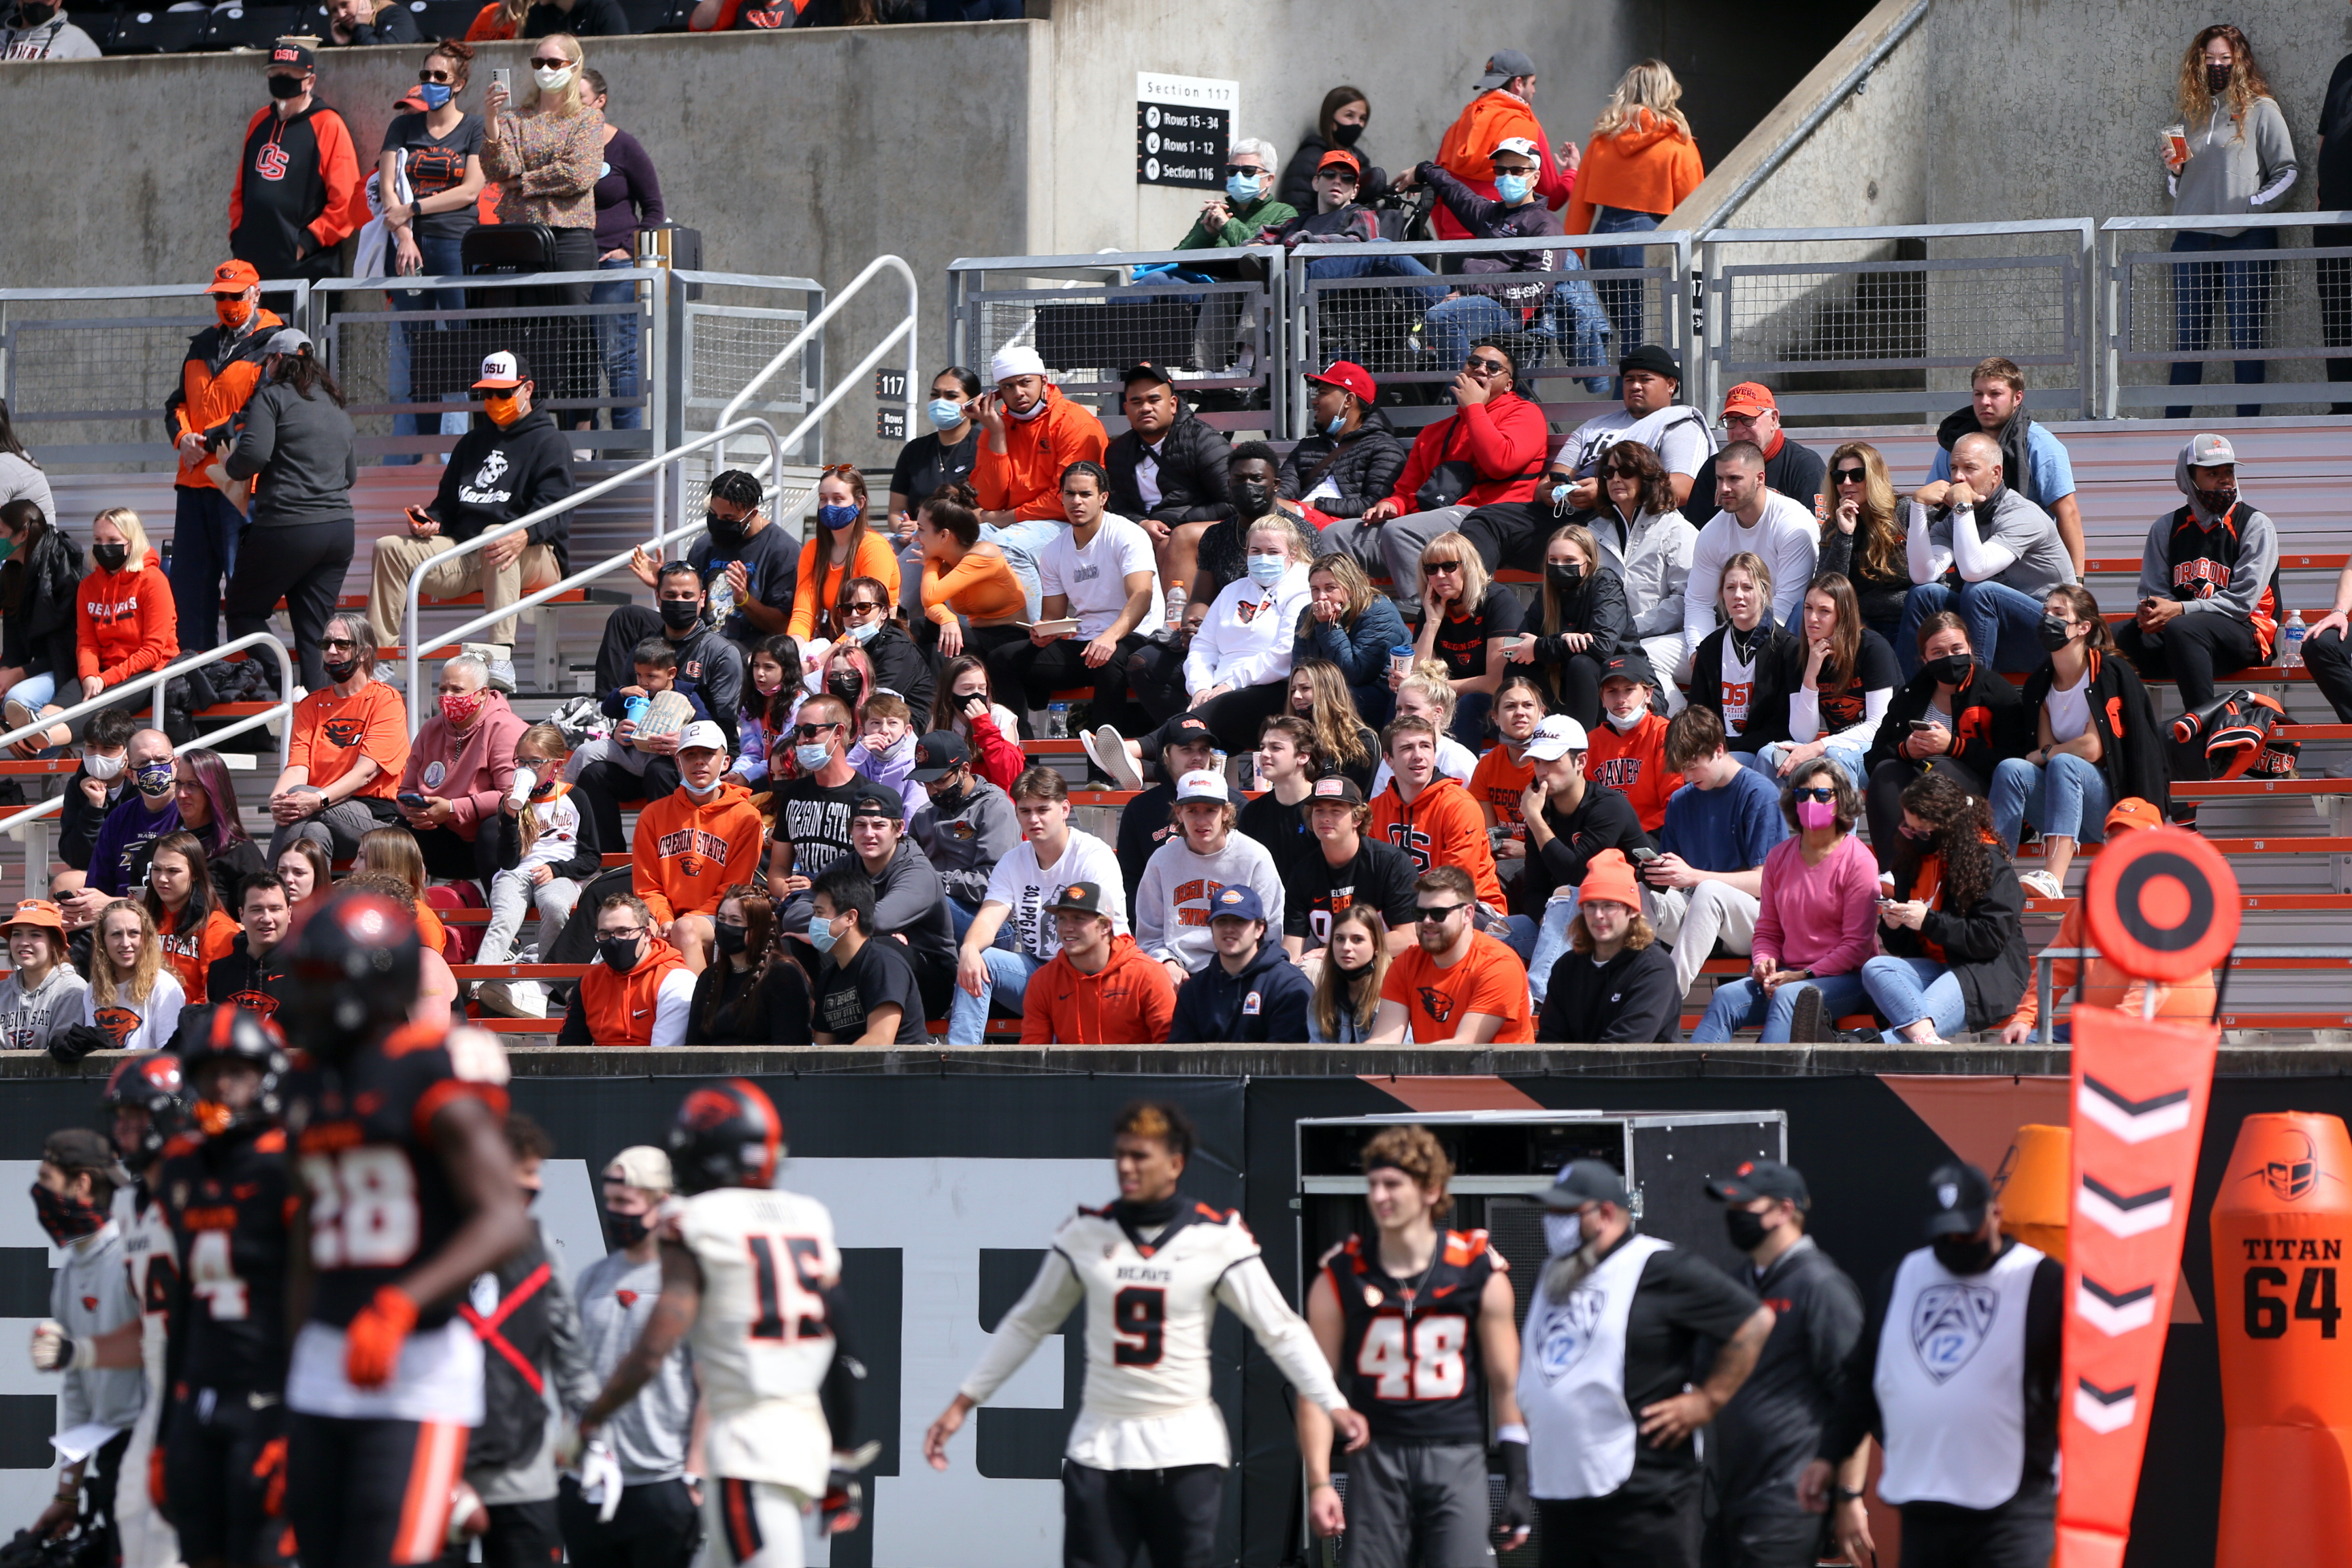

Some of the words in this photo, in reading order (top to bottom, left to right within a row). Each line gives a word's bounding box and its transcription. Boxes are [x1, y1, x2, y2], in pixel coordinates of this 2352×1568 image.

[274, 48, 299, 61] OSU
[1147, 82, 1199, 98] Section
[1207, 88, 1230, 101] 117
[1163, 112, 1188, 127] Rows
[1163, 137, 1188, 153] Rows
[1163, 164, 1196, 180] Section
[1199, 167, 1214, 181] 116
[485, 363, 506, 374] OSU
[882, 375, 905, 395] 117
[884, 412, 904, 424] Rows
[458, 485, 512, 504] Marines
[689, 725, 700, 736] 2
[2276, 728, 2284, 736] 18
[2266, 783, 2274, 791] 19
[785, 799, 826, 841] OREGON
[657, 828, 695, 859] OREGON
[696, 831, 729, 866] STATE
[2255, 841, 2264, 849] 20
[1022, 885, 1041, 904] 30.1
[1173, 879, 1205, 906] OREGON
[1018, 905, 1038, 930] PPG
[998, 1021, 1006, 1029] 12
[2243, 1239, 2342, 1260] TITAN
[191, 1230, 251, 1322] 4
[2244, 1267, 2342, 1339] 64
[1114, 1286, 1166, 1367] 9
[1358, 1314, 1468, 1400] 48
[1930, 1334, 1965, 1363] 12
